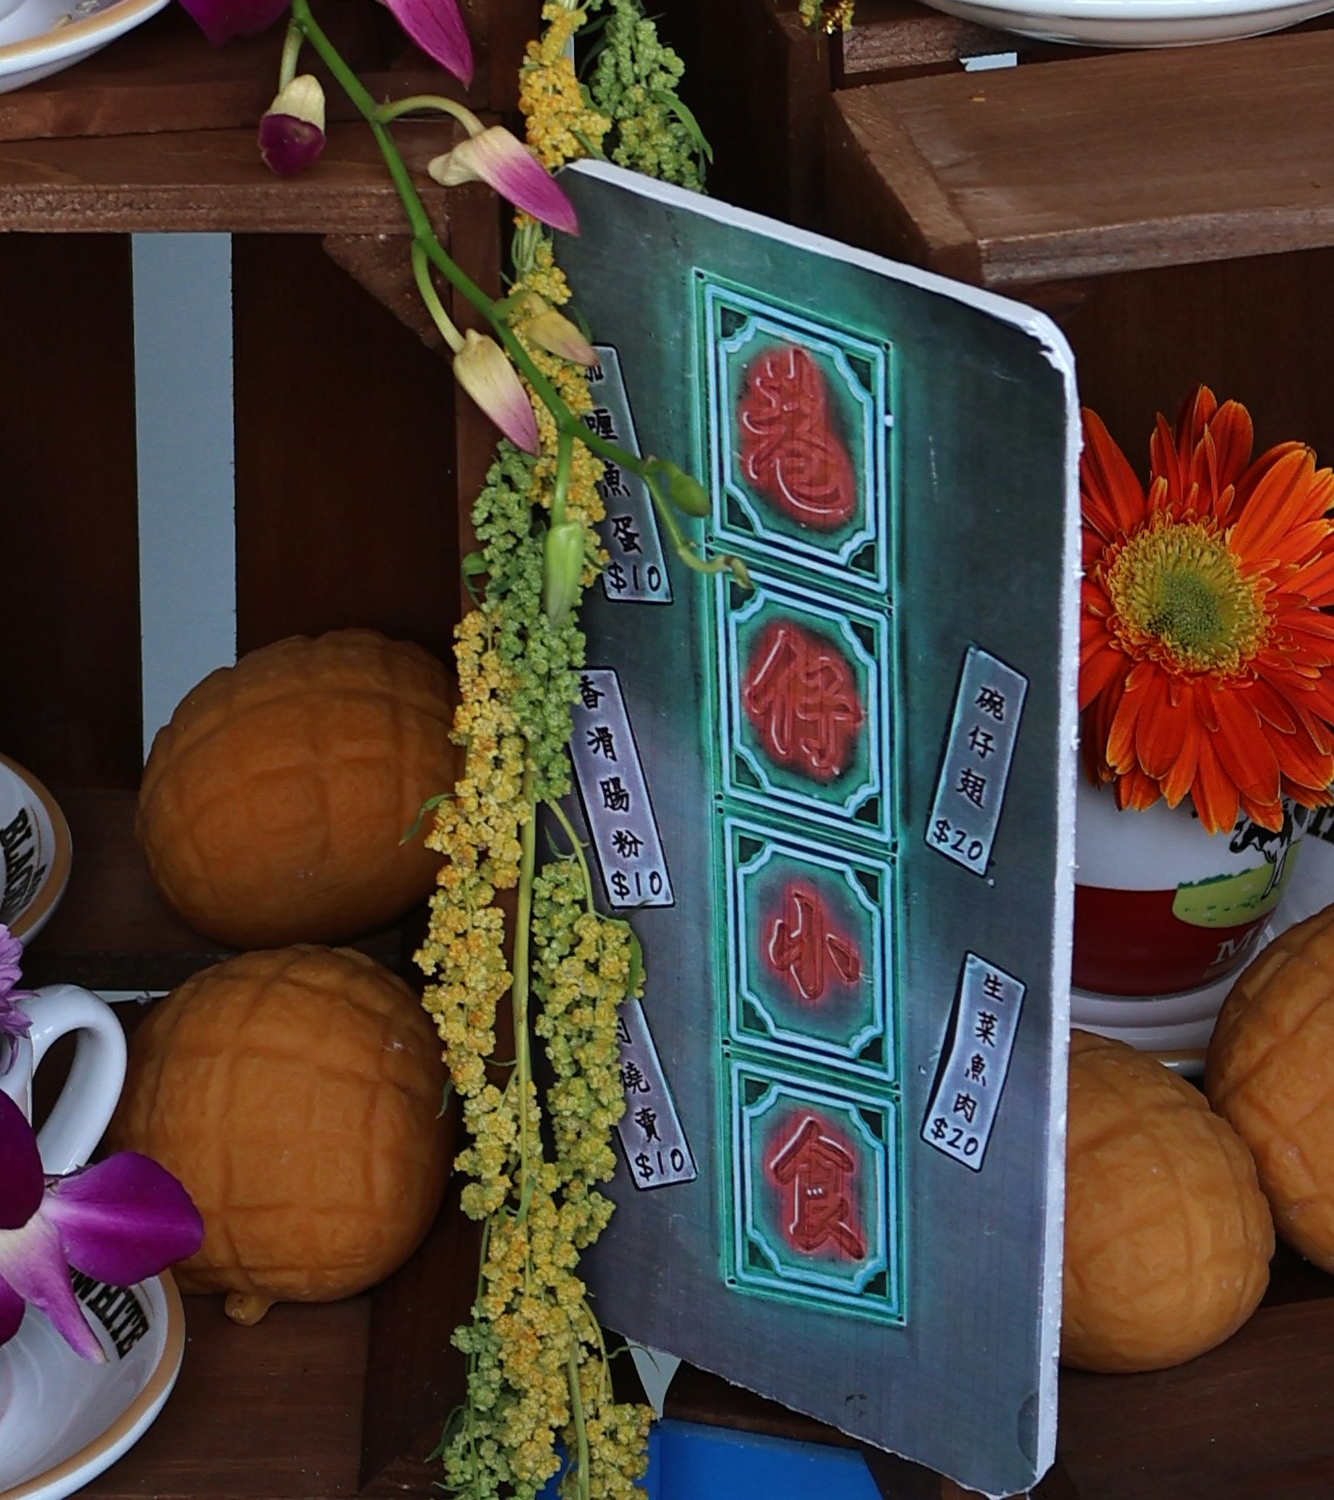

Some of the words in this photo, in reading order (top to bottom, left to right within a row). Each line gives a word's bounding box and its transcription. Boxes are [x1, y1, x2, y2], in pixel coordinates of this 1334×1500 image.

[606, 560, 662, 596] $10
[932, 817, 986, 863] $20
[610, 869, 664, 903] $10
[929, 1113, 981, 1158] $20
[633, 1147, 686, 1182] $10
